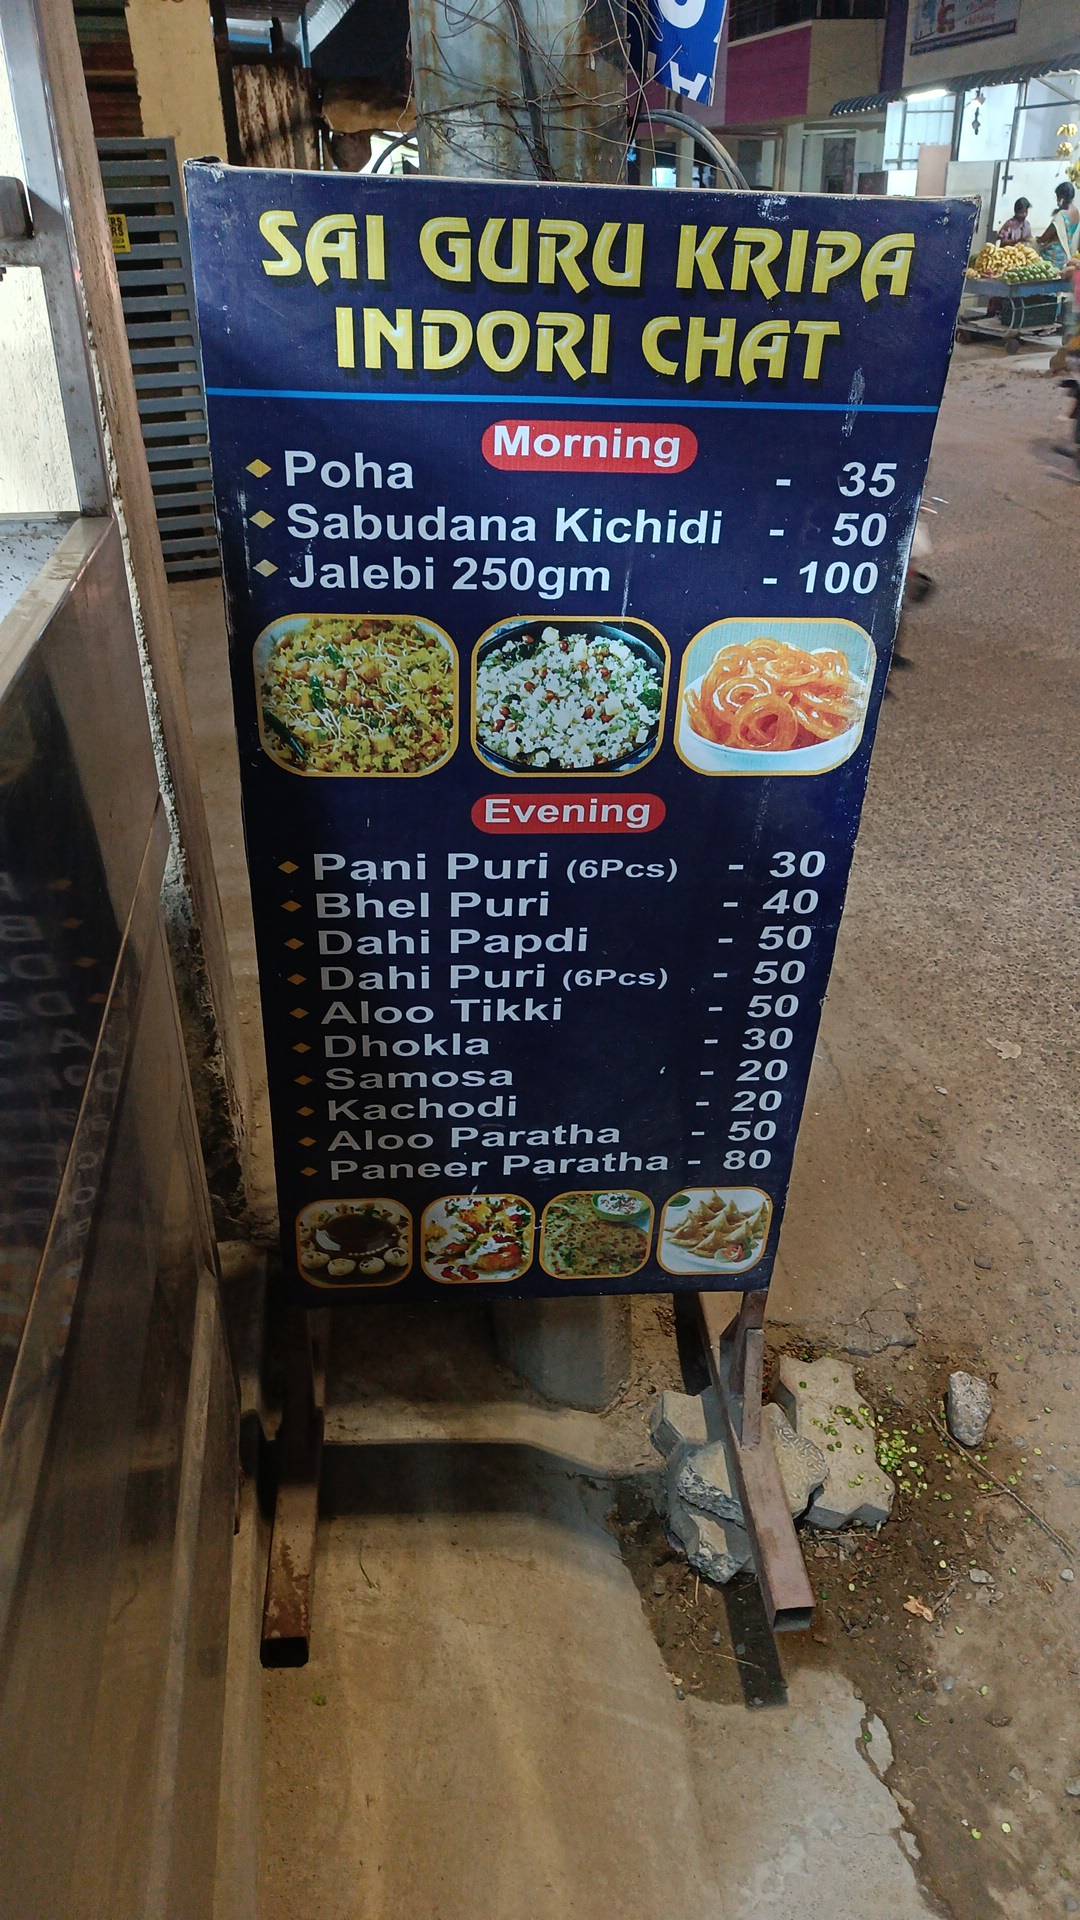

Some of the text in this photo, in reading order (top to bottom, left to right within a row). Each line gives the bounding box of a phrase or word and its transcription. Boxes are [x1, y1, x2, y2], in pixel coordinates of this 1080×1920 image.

[260, 211, 915, 302] SAI GURU KRIPA
[336, 308, 840, 384] INDORI CHAT
[494, 425, 680, 467] Morning
[285, 451, 413, 489] Poha
[839, 462, 897, 497] 35
[288, 504, 535, 541] Sabudana
[556, 508, 722, 543] Kichidi
[832, 513, 886, 546] 50
[290, 555, 433, 589] Jalebi
[453, 557, 609, 599] 250gm
[800, 561, 878, 594] 100
[486, 799, 649, 828] Evening
[314, 854, 425, 880] Pani
[448, 853, 547, 879] Puri
[567, 859, 677, 883] (6Pcs)
[770, 851, 825, 877] 30
[317, 893, 429, 918] Bhel
[451, 891, 548, 917] Puri
[763, 890, 818, 914] 40
[319, 930, 429, 954] Dahi
[451, 928, 587, 959] Papdi
[759, 926, 811, 950] 50
[321, 966, 429, 989] Dahi
[451, 964, 544, 988] Puri
[563, 968, 667, 991] (6Pcs)
[753, 960, 805, 984] 50
[322, 1001, 433, 1024] Aloo
[451, 998, 561, 1022] Tikki
[747, 995, 798, 1017] 50
[325, 1033, 488, 1057] Dhokla
[742, 1028, 793, 1050] 30
[327, 1069, 512, 1089] Samosa
[736, 1060, 787, 1081] 20
[329, 1096, 516, 1120] Kachodi
[731, 1091, 781, 1111] 20
[328, 1130, 433, 1151] Aloo
[452, 1124, 619, 1147] Paratha
[728, 1121, 776, 1141] 50
[331, 1161, 488, 1180] Paneer
[504, 1152, 667, 1175] Paratha
[723, 1150, 771, 1169] 80
